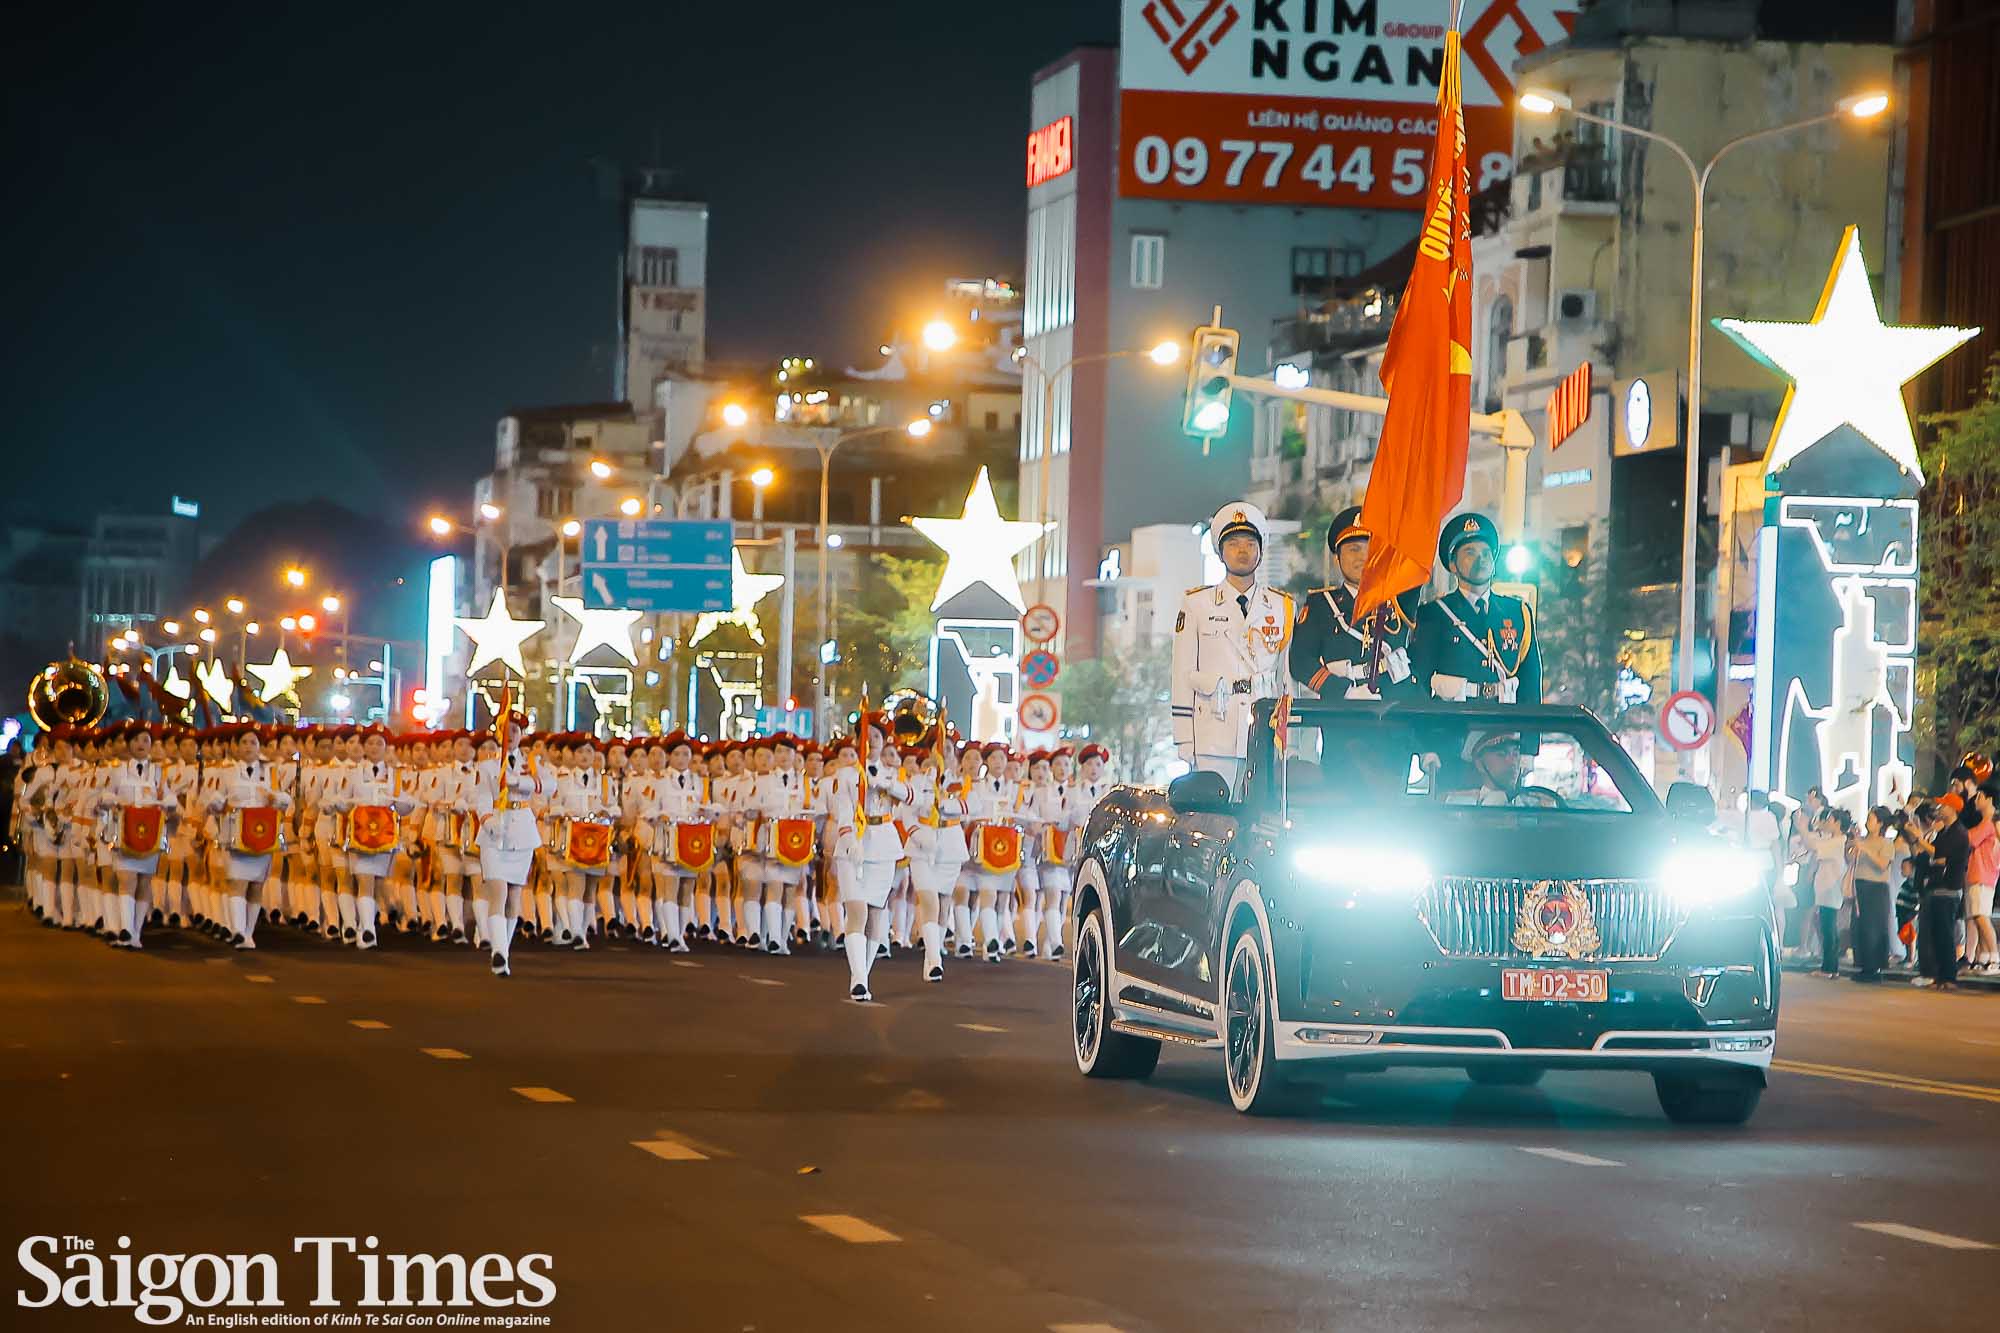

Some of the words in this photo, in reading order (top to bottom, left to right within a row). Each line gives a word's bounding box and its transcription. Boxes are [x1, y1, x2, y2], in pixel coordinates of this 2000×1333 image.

[1253, 0, 1377, 36] KIM
[1383, 22, 1443, 40] GROUP
[1251, 39, 1443, 87] NGAN
[1247, 108, 1290, 127] LIÊN
[1293, 109, 1319, 131] HỆ
[1133, 135, 1208, 186] 09
[1220, 139, 1293, 188] 77
[1300, 143, 1375, 192] 44
[1505, 972, 1604, 999] TM-02-50
